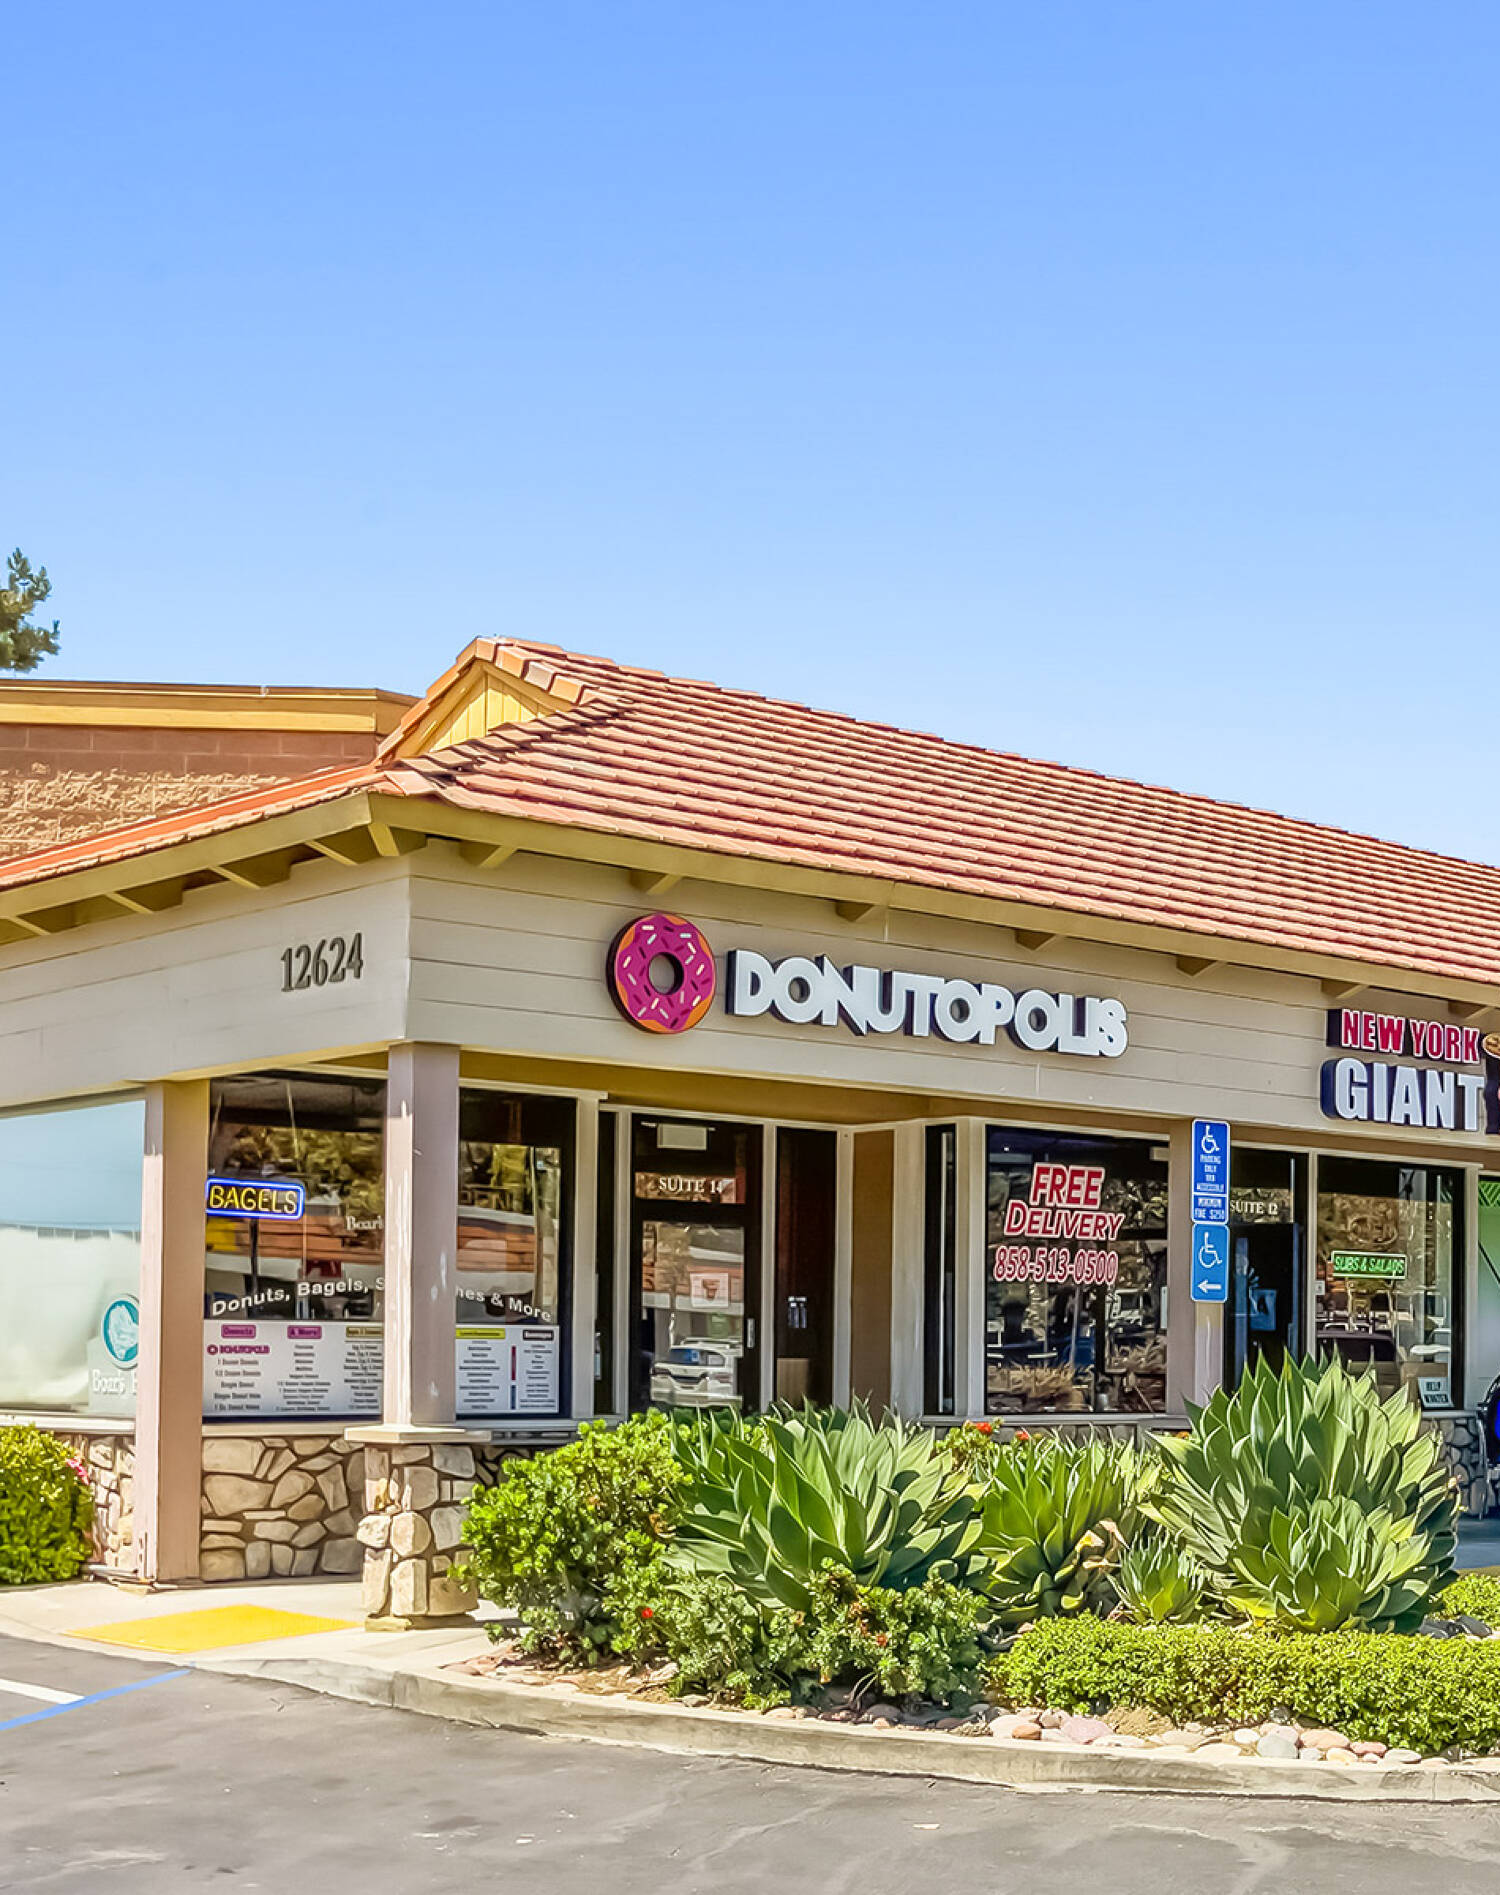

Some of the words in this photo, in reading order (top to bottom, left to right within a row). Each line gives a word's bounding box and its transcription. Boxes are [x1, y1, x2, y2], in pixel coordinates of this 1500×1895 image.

[281, 932, 364, 993] 12624
[732, 949, 1129, 1058] DONUTOPOLIS
[1340, 1008, 1406, 1055] NEW
[1409, 1019, 1481, 1065] YORK
[1333, 1057, 1485, 1132] GIANT
[208, 1184, 298, 1215] BAGELS
[658, 1175, 706, 1194] SUITE
[1029, 1162, 1106, 1209] FREE
[1004, 1199, 1126, 1241] DELIVERY
[1230, 1199, 1265, 1215] SUITE
[993, 1245, 1119, 1285] 858-513-0500
[1334, 1255, 1358, 1272] SUBS
[1368, 1257, 1405, 1274] SALADS
[211, 1287, 291, 1317] Donuts,
[296, 1277, 369, 1297] Bagels,
[490, 1291, 505, 1308] &
[508, 1296, 552, 1323] More
